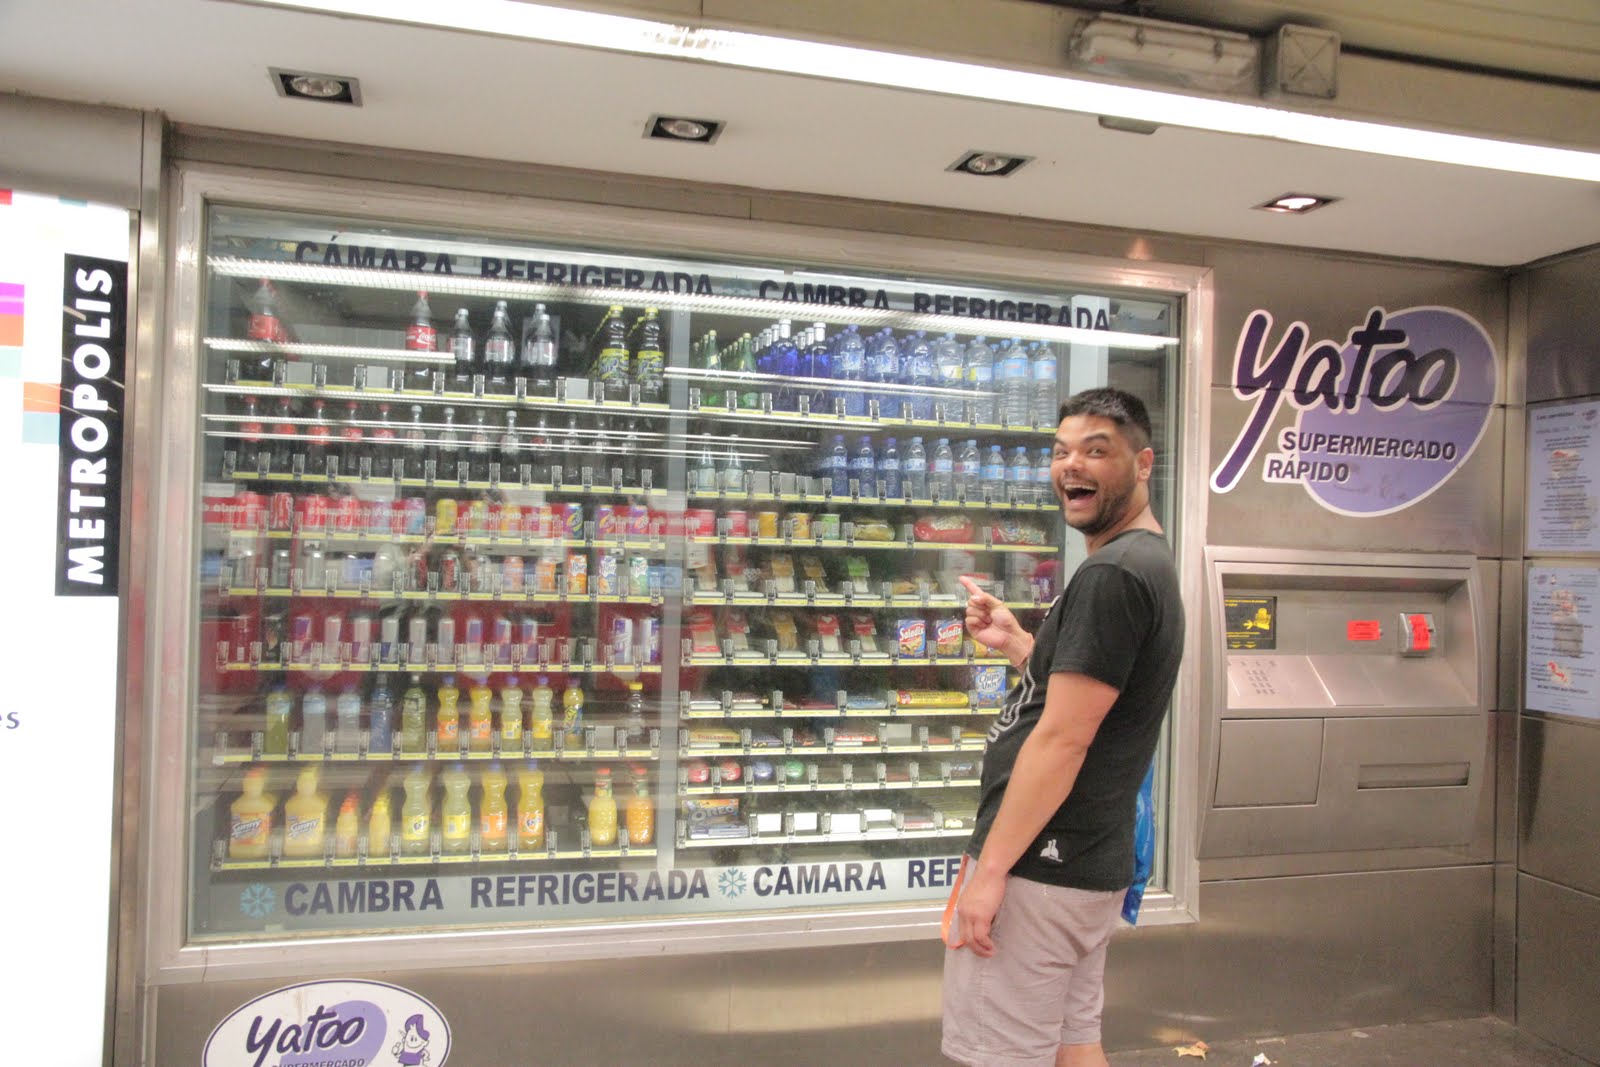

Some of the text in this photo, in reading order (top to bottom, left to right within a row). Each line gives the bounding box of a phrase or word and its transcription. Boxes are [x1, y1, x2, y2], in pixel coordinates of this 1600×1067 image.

[481, 257, 713, 296] REFRIGERADA
[914, 292, 1109, 331] REFRIGERADA
[67, 267, 113, 585] METROPOLIS
[1281, 431, 1457, 461] SUPERMERCADO
[1267, 454, 1350, 482] RÁPIDO
[691, 805, 734, 822] OREO
[284, 868, 710, 917] CAMBRA REFRIGERADA
